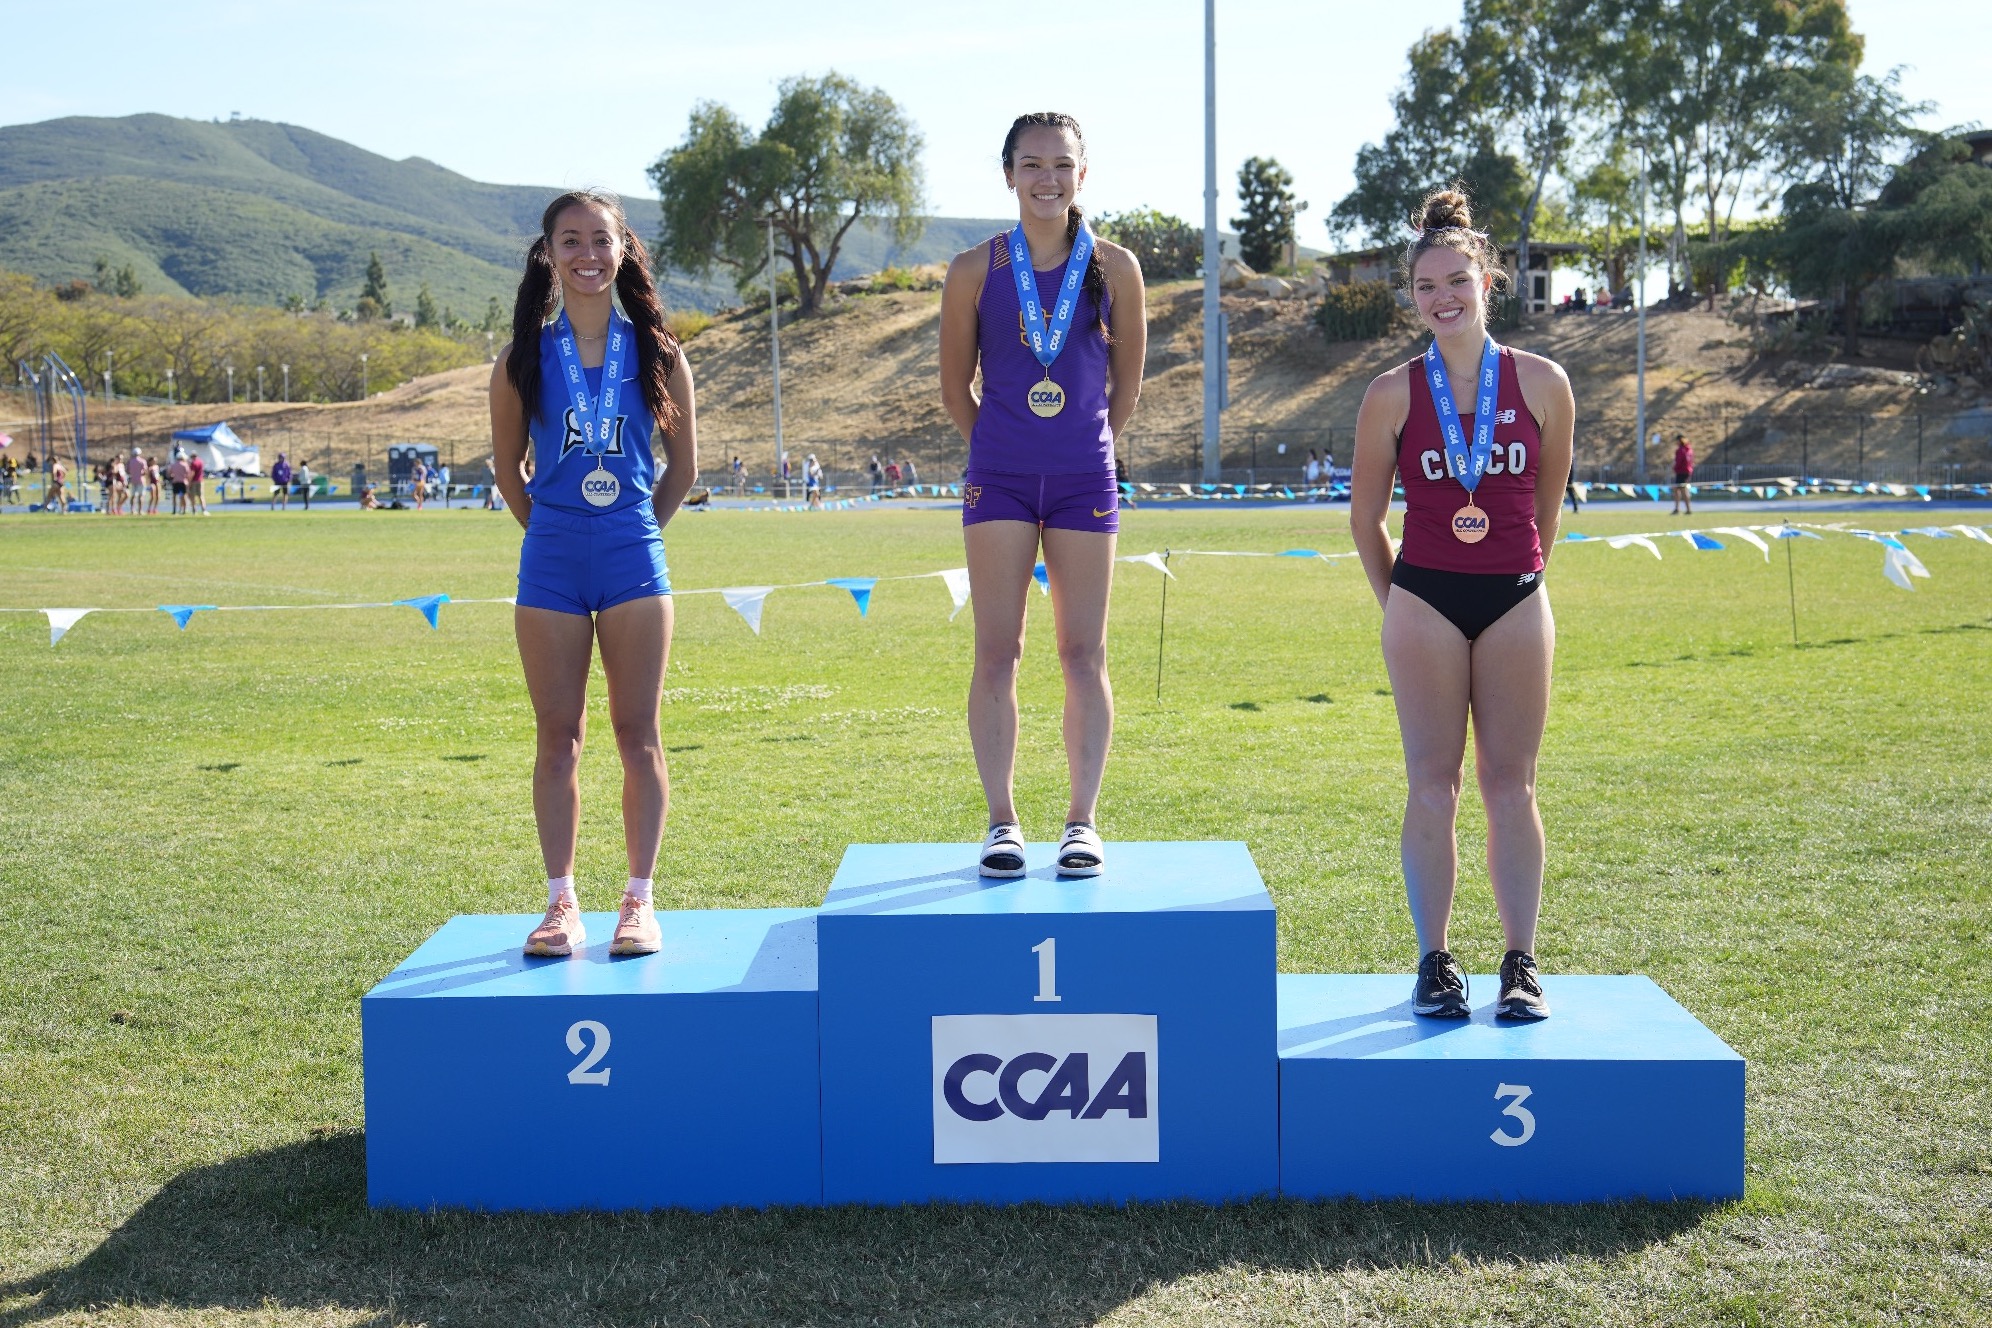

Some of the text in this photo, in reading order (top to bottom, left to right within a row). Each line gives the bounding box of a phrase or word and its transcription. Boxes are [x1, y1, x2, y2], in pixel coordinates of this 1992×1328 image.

[1015, 243, 1024, 262] CCAA
[1076, 242, 1087, 260] CCAA
[1020, 271, 1030, 291] CCAA
[1067, 270, 1079, 289] CCAA
[1027, 301, 1037, 320] CCAA
[1059, 300, 1070, 320] CCAA
[562, 338, 572, 356] CCAA
[612, 333, 621, 351] CCAA
[1033, 331, 1042, 352] CCAA
[1050, 330, 1062, 350] CCAA
[569, 365, 580, 383] CCAA
[608, 361, 618, 378] CCAA
[1433, 370, 1443, 388] CCAA
[1485, 369, 1493, 387] CCAA
[576, 392, 588, 412] CCAA
[605, 388, 614, 407] CCAA
[1031, 392, 1061, 403] CCAA
[1440, 397, 1451, 415] CCAA
[1482, 396, 1491, 415] CCAA
[585, 422, 593, 442] CCAA
[601, 418, 610, 439] CCAA
[1448, 424, 1459, 444] CCAA
[1479, 425, 1488, 444] CCAA
[1421, 442, 1526, 480] CCO
[585, 481, 615, 492] CCAA
[1455, 517, 1485, 528] CCAA
[1032, 938, 1061, 1001] 1
[566, 1020, 611, 1086] 2
[944, 1052, 1147, 1121] CCAA
[1490, 1083, 1535, 1146] 3
